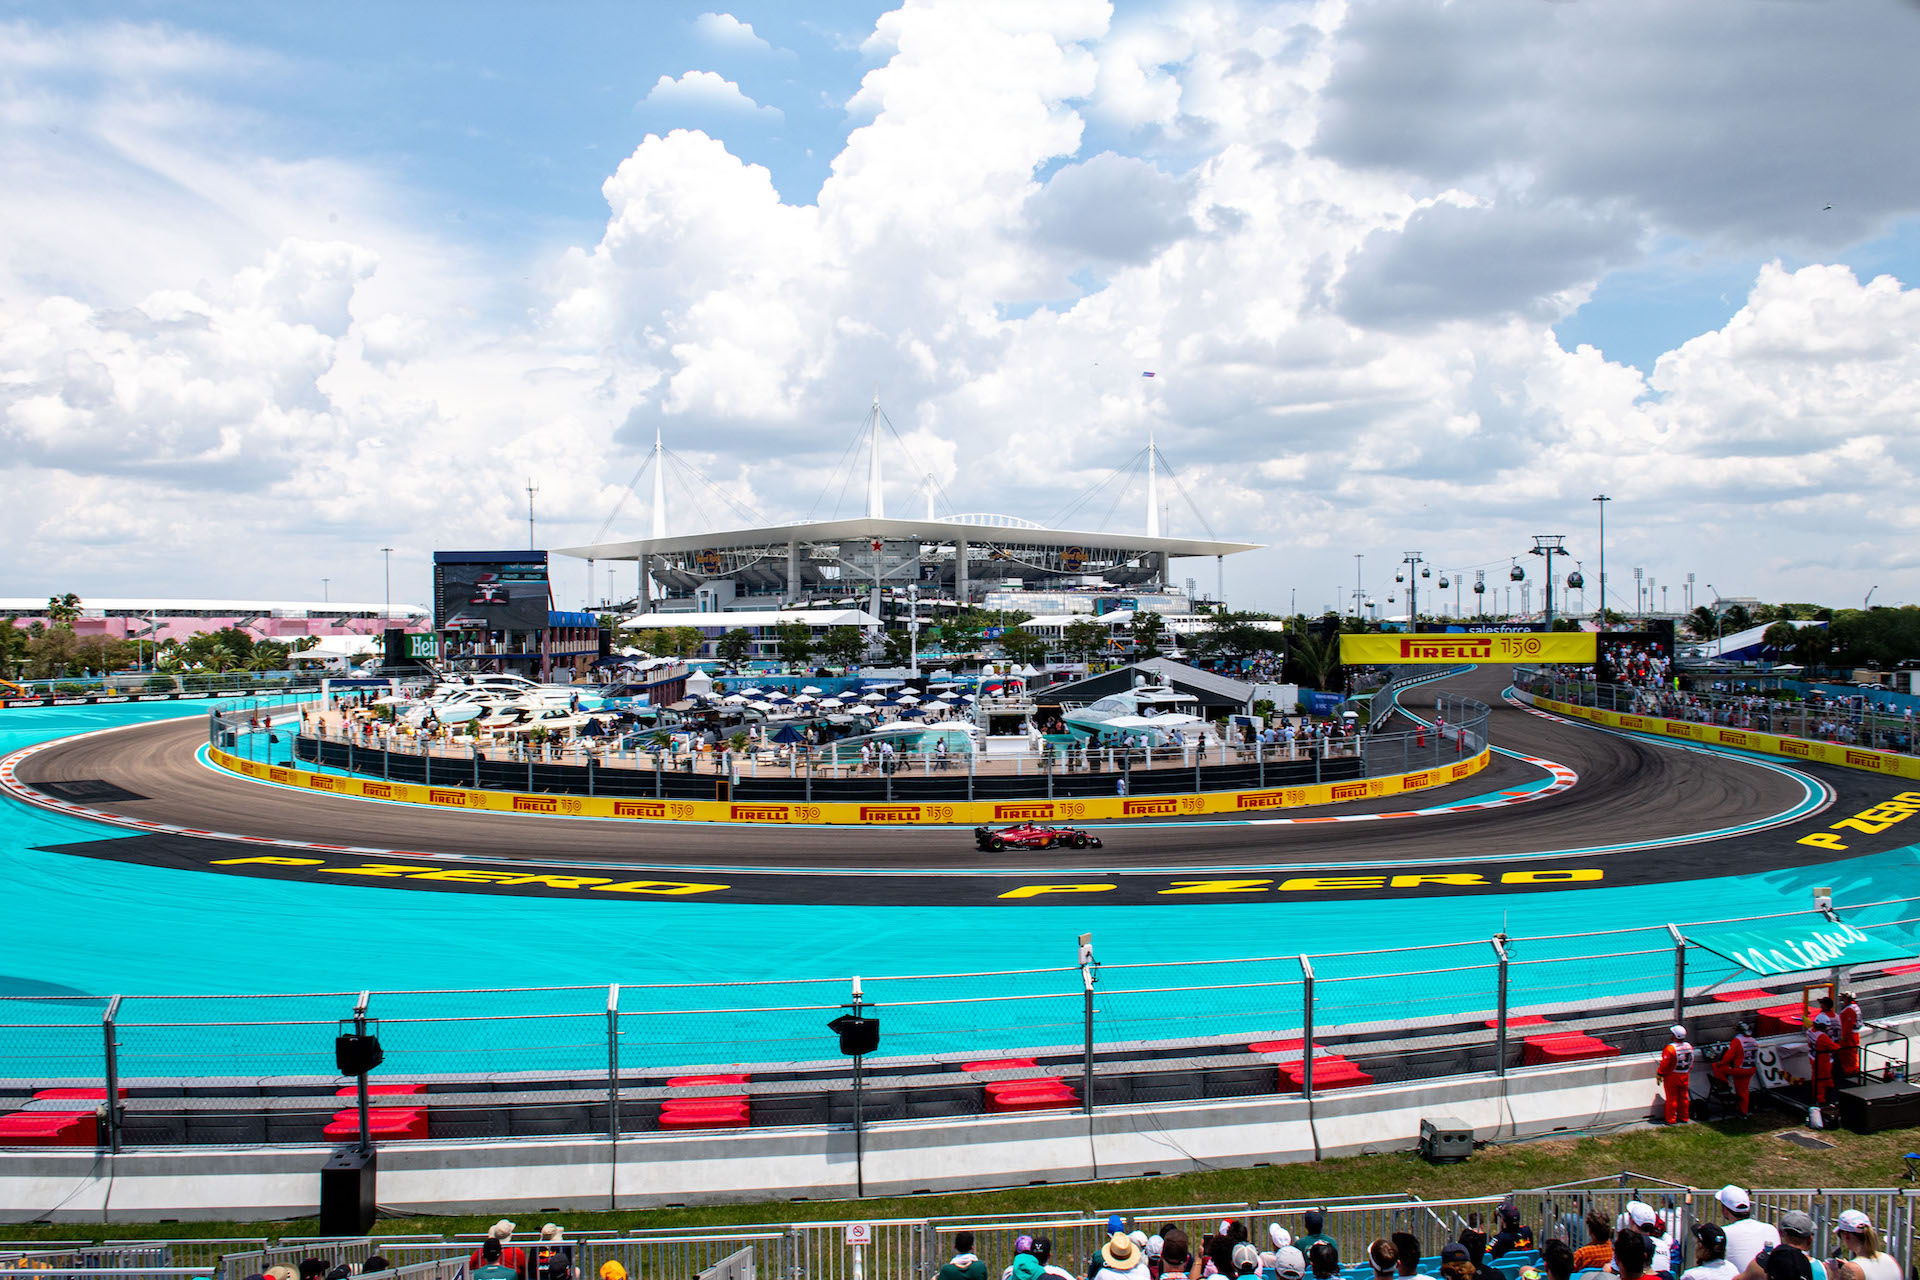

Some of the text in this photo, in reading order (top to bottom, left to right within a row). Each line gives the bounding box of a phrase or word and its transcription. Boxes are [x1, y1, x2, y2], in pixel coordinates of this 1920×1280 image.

[1469, 624, 1532, 633] salesforce
[1400, 638, 1541, 658] PIRELLI 150
[737, 681, 760, 690] MSC
[1719, 731, 1746, 745] PIRELLI
[1779, 740, 1809, 755] PIRELLI
[1846, 751, 1880, 768] PIRELLI
[311, 776, 333, 790] PIRELLI
[1403, 773, 1428, 789] PIRELLI
[363, 783, 391, 797] PIRELLI
[430, 790, 465, 805] PIRELLI
[1331, 783, 1367, 800] PIRELLI
[513, 797, 582, 813] PIRELLI 150
[1123, 798, 1205, 814] PIRELLI 150
[1237, 790, 1305, 808] PIRELLI 150
[614, 802, 694, 817] PIRELLI 150
[731, 806, 820, 821] PIRELLI 150
[860, 806, 953, 821] PIRELLI 150
[995, 803, 1085, 819] PIRELLI 150
[1796, 832, 1849, 850] P
[209, 856, 731, 895] P ZERO
[997, 869, 1604, 899] P ZERO
[1731, 923, 1868, 975] Miami
[1759, 1050, 1783, 1081] SC
